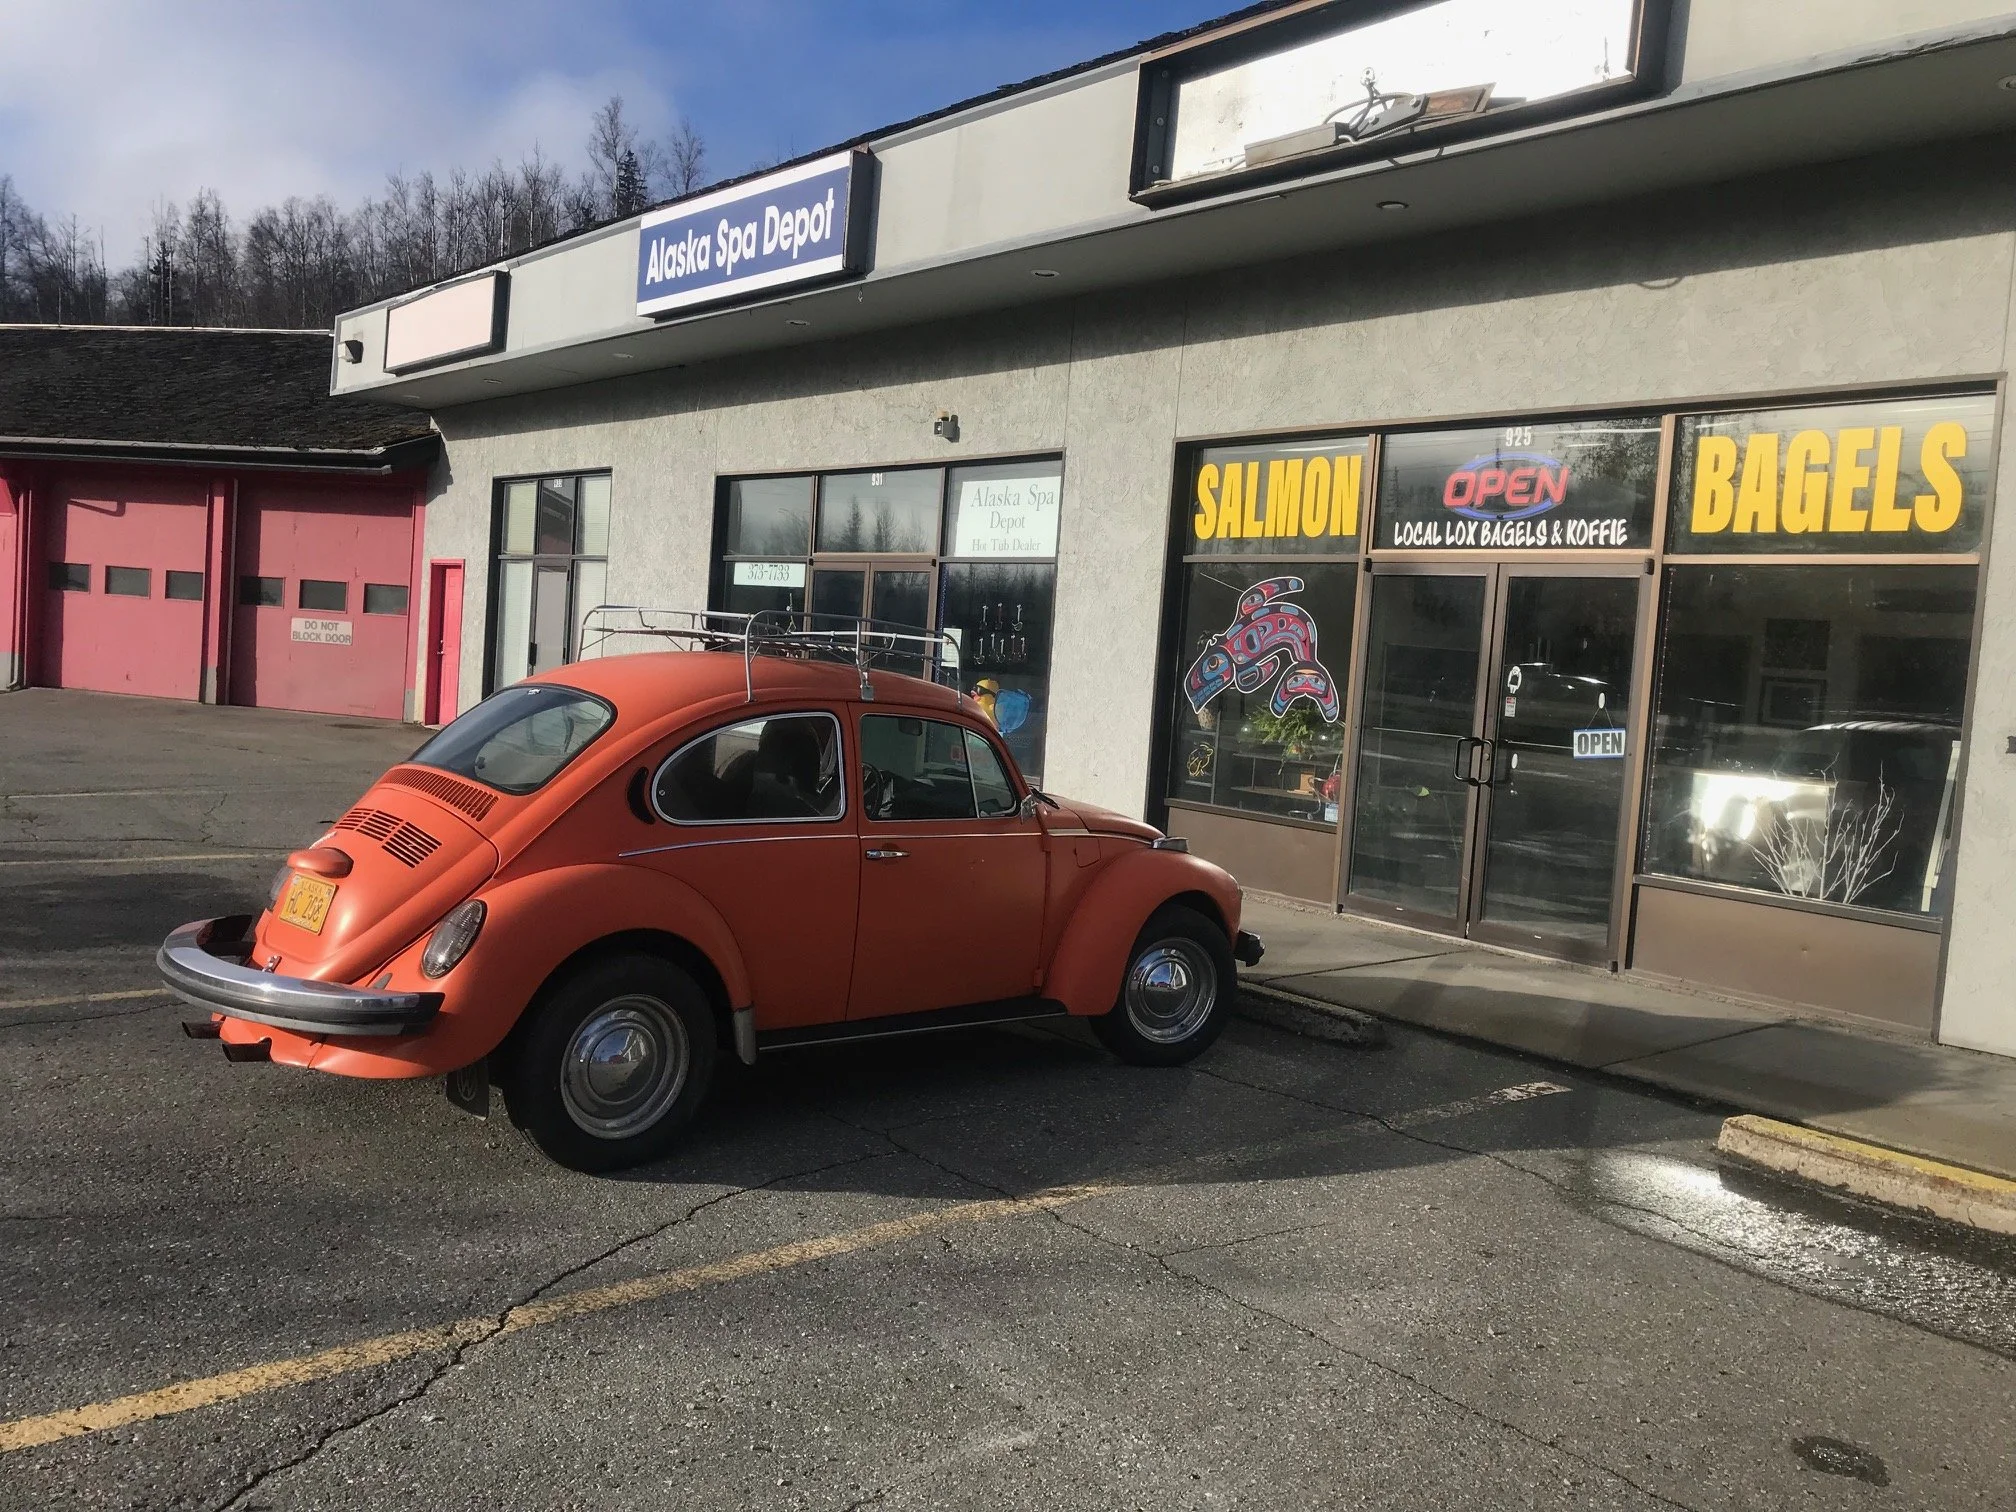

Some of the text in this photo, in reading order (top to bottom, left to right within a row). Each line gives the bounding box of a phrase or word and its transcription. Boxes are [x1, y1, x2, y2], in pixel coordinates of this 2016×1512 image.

[645, 187, 835, 286] Alaska Spa Depot
[1505, 426, 1533, 447] 925
[871, 472, 883, 486] 931
[1442, 465, 1571, 508] OPEN
[1691, 421, 1967, 534] BAGELS
[970, 483, 1055, 511] Alaska Spa
[1194, 455, 1362, 540] SALMON
[989, 511, 1026, 533] Depot
[1394, 518, 1628, 547] LOCAL LOX BAGELS & KOFFIE
[971, 537, 1042, 552] Hot Tub Dealer
[747, 563, 790, 582] 373-7733
[292, 630, 352, 644] BLOCK DOOR
[304, 620, 340, 631] DO NOT
[1577, 732, 1623, 756] OPEN
